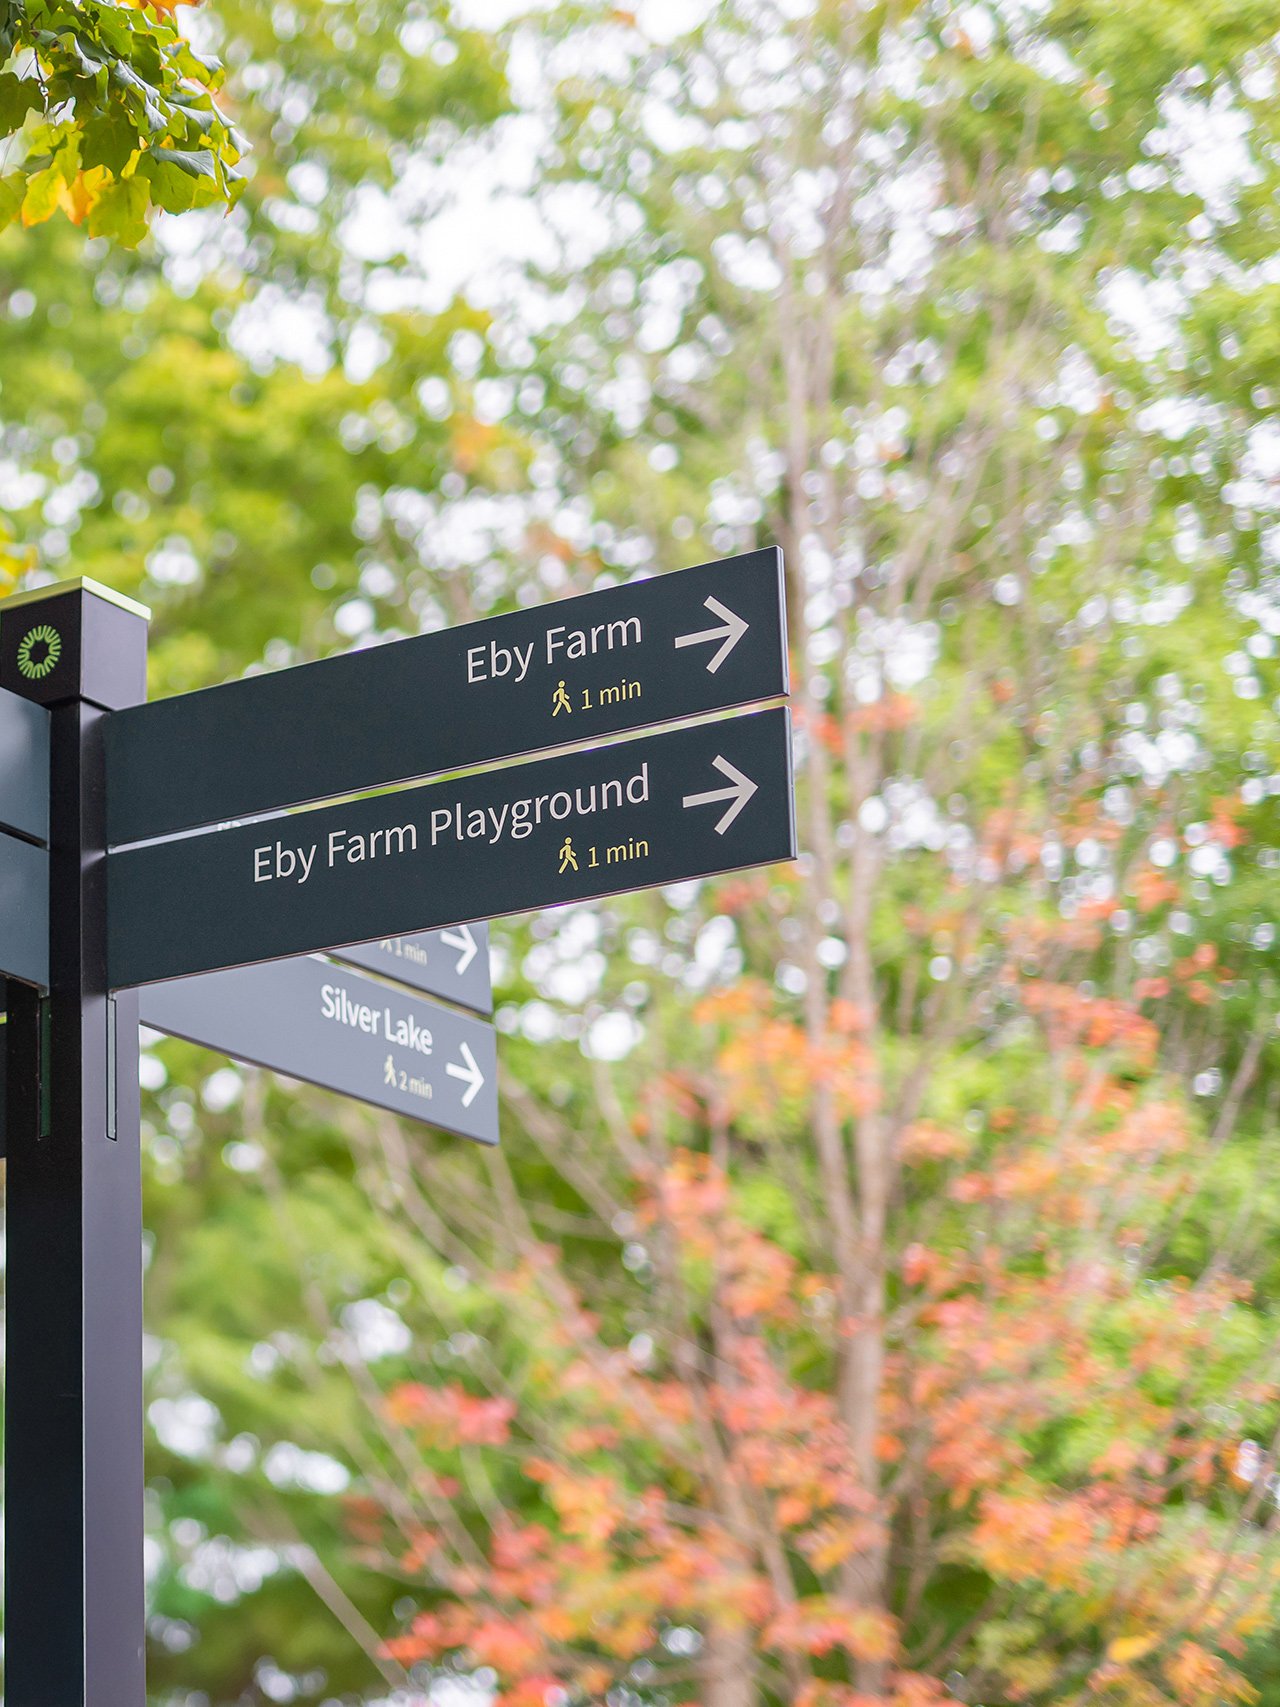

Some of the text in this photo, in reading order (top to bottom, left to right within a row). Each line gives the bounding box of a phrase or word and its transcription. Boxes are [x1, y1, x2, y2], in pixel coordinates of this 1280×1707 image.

[467, 617, 642, 684] Eby Farm
[581, 678, 641, 710] 1 min
[254, 762, 649, 884] Eby Farm Playground
[588, 836, 649, 868] 1 min
[395, 937, 428, 965] 1 min
[321, 984, 433, 1056] Silver Lake
[398, 1070, 433, 1100] 2 min
